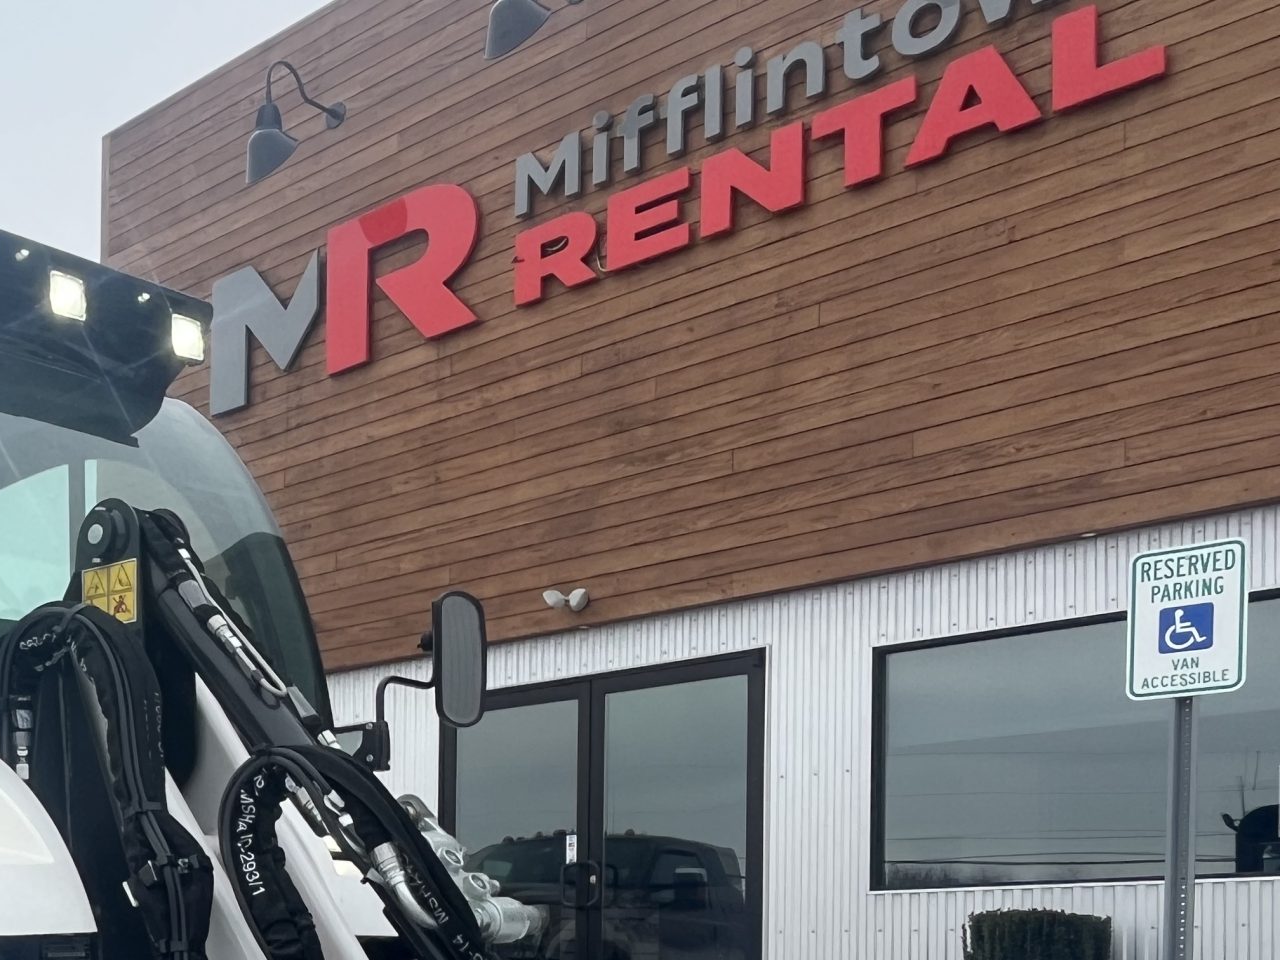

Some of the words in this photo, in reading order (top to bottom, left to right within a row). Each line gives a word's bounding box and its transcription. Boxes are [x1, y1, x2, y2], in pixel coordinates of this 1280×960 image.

[514, 4, 1166, 306] RENTAL
[1141, 549, 1236, 582] RESERVED
[1151, 576, 1224, 603] PARKING
[1172, 657, 1200, 671] VAN
[1141, 669, 1230, 690] ACCESSIBLE
